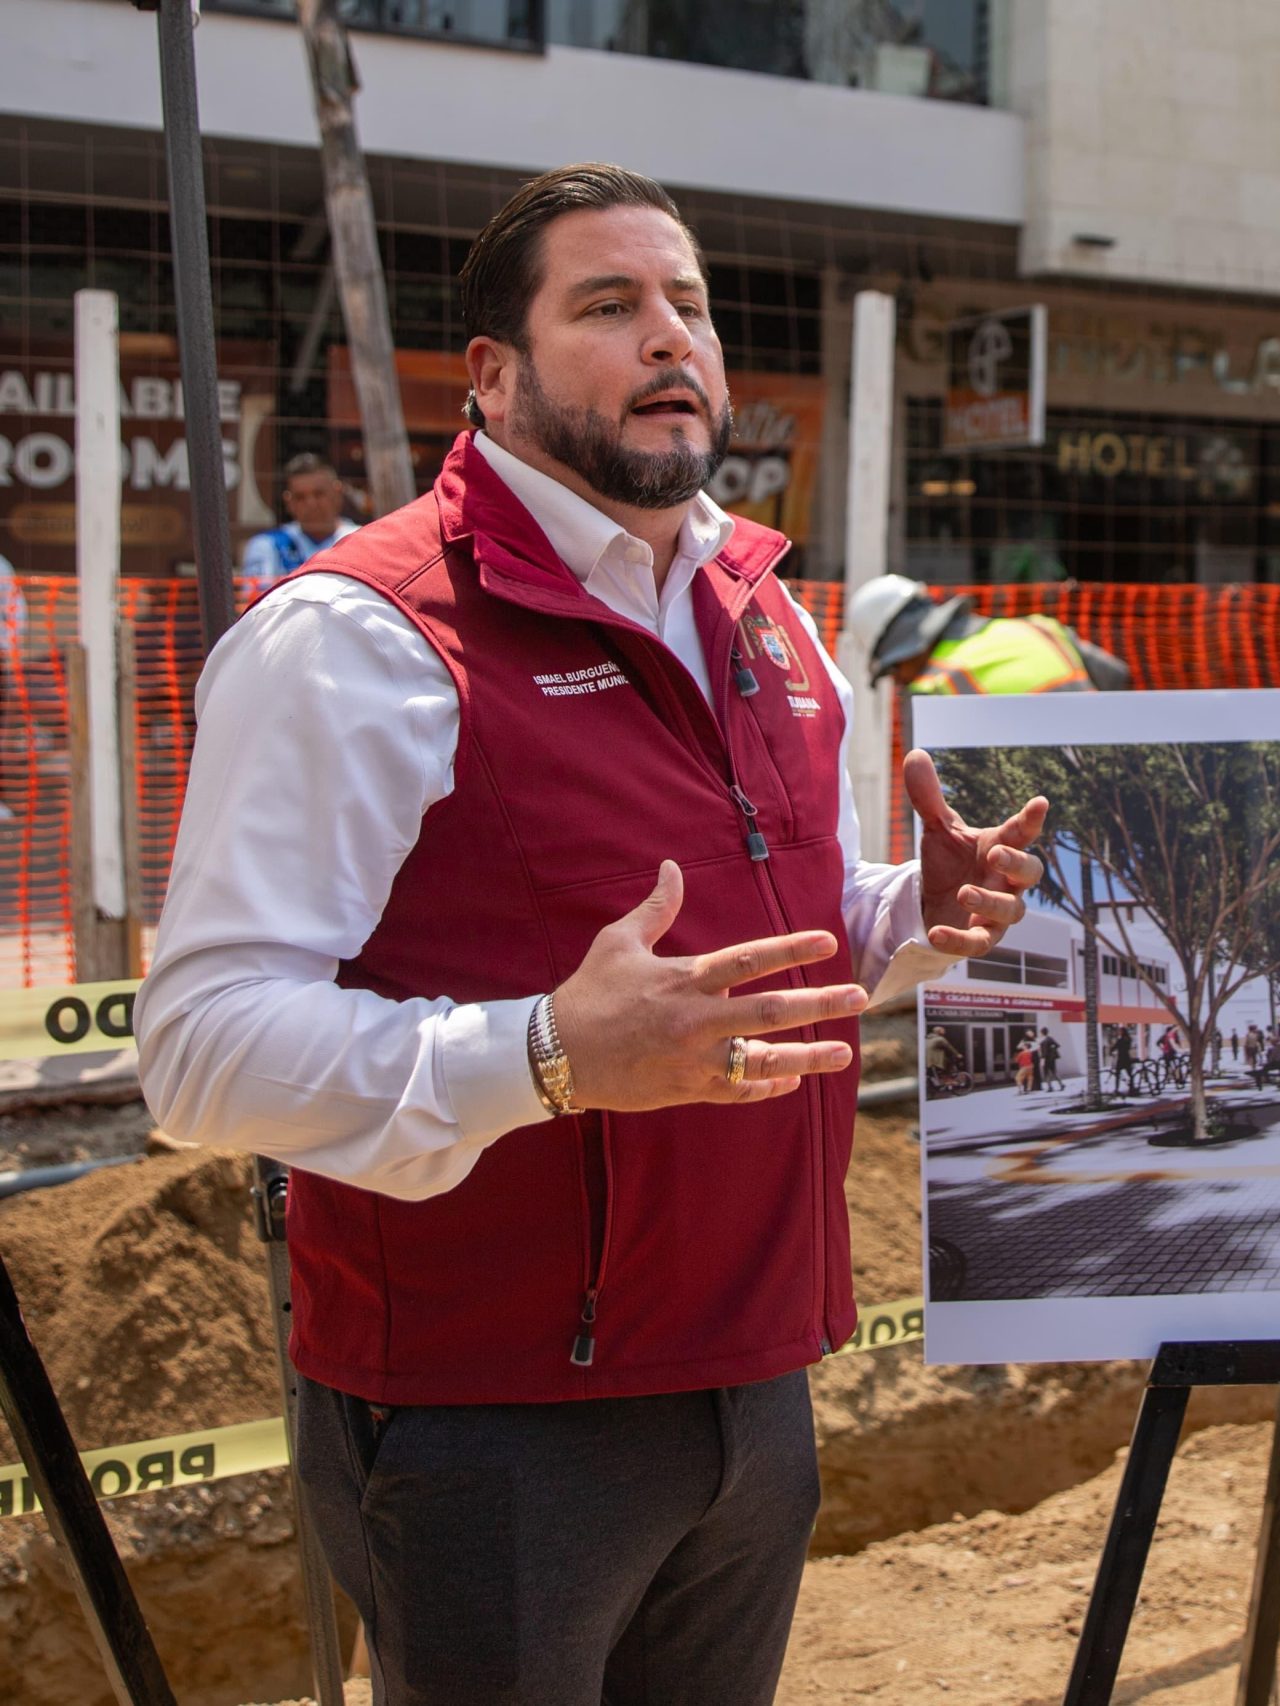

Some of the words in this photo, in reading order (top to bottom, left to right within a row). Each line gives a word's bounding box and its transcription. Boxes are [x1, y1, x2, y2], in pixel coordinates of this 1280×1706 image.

[1057, 430, 1197, 479] HOTEL
[533, 673, 567, 685] ISMAEL
[541, 682, 597, 696] PRESIDENTE
